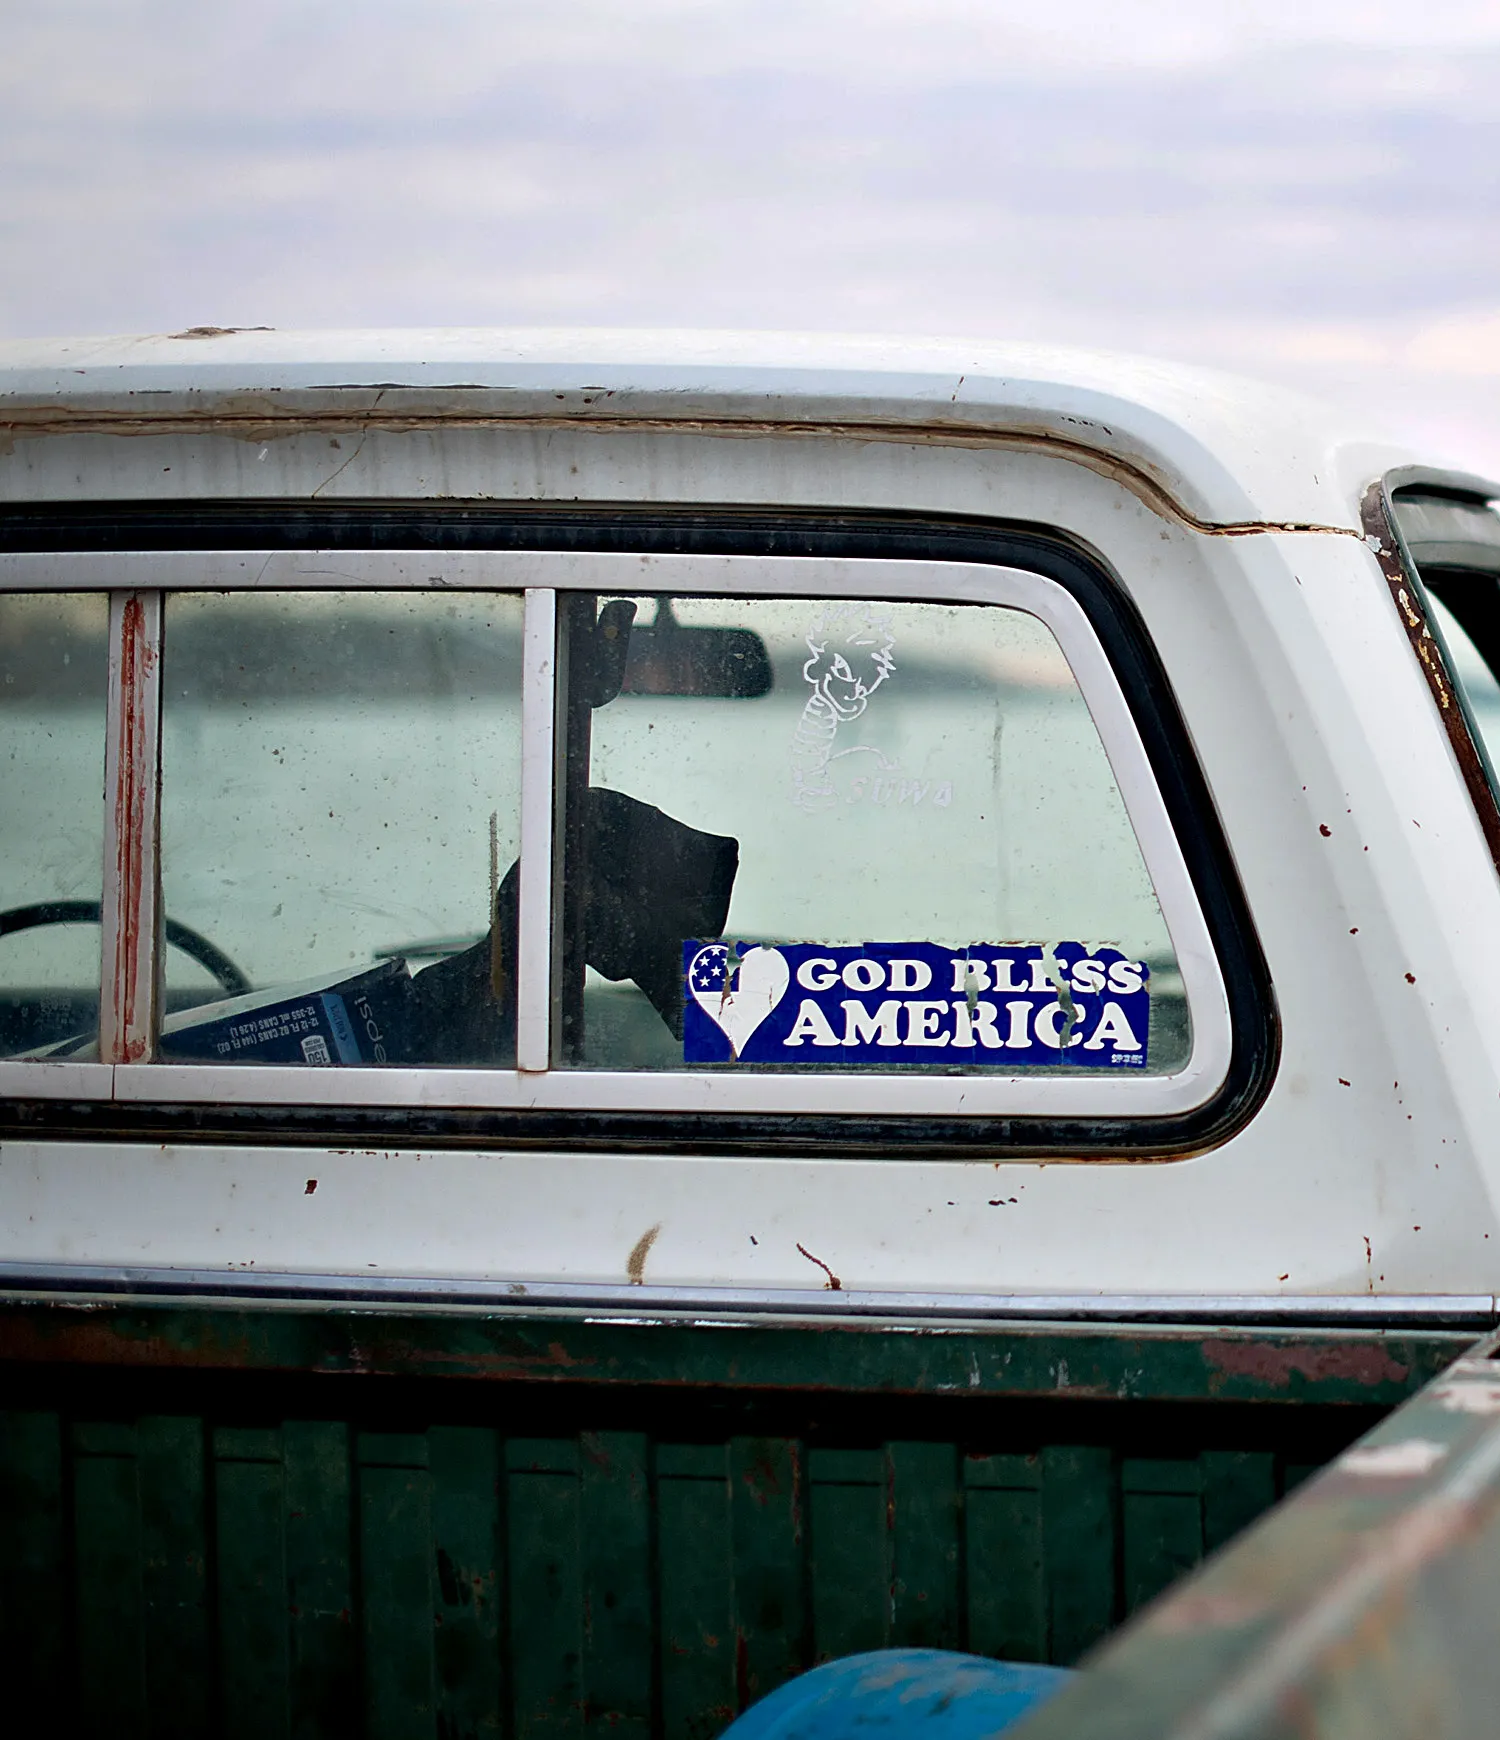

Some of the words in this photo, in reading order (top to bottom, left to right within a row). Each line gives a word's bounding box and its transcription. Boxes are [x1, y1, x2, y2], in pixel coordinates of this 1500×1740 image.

[796, 958, 932, 992] GOD
[950, 959, 1143, 994] BLESS
[258, 1016, 279, 1030] CANS
[289, 1022, 300, 1033] FL
[300, 1017, 319, 1030] 12-12
[354, 996, 387, 1064] epsi
[783, 998, 1143, 1051] AMERICA
[257, 1028, 279, 1042] CANS
[231, 1038, 242, 1050] FL
